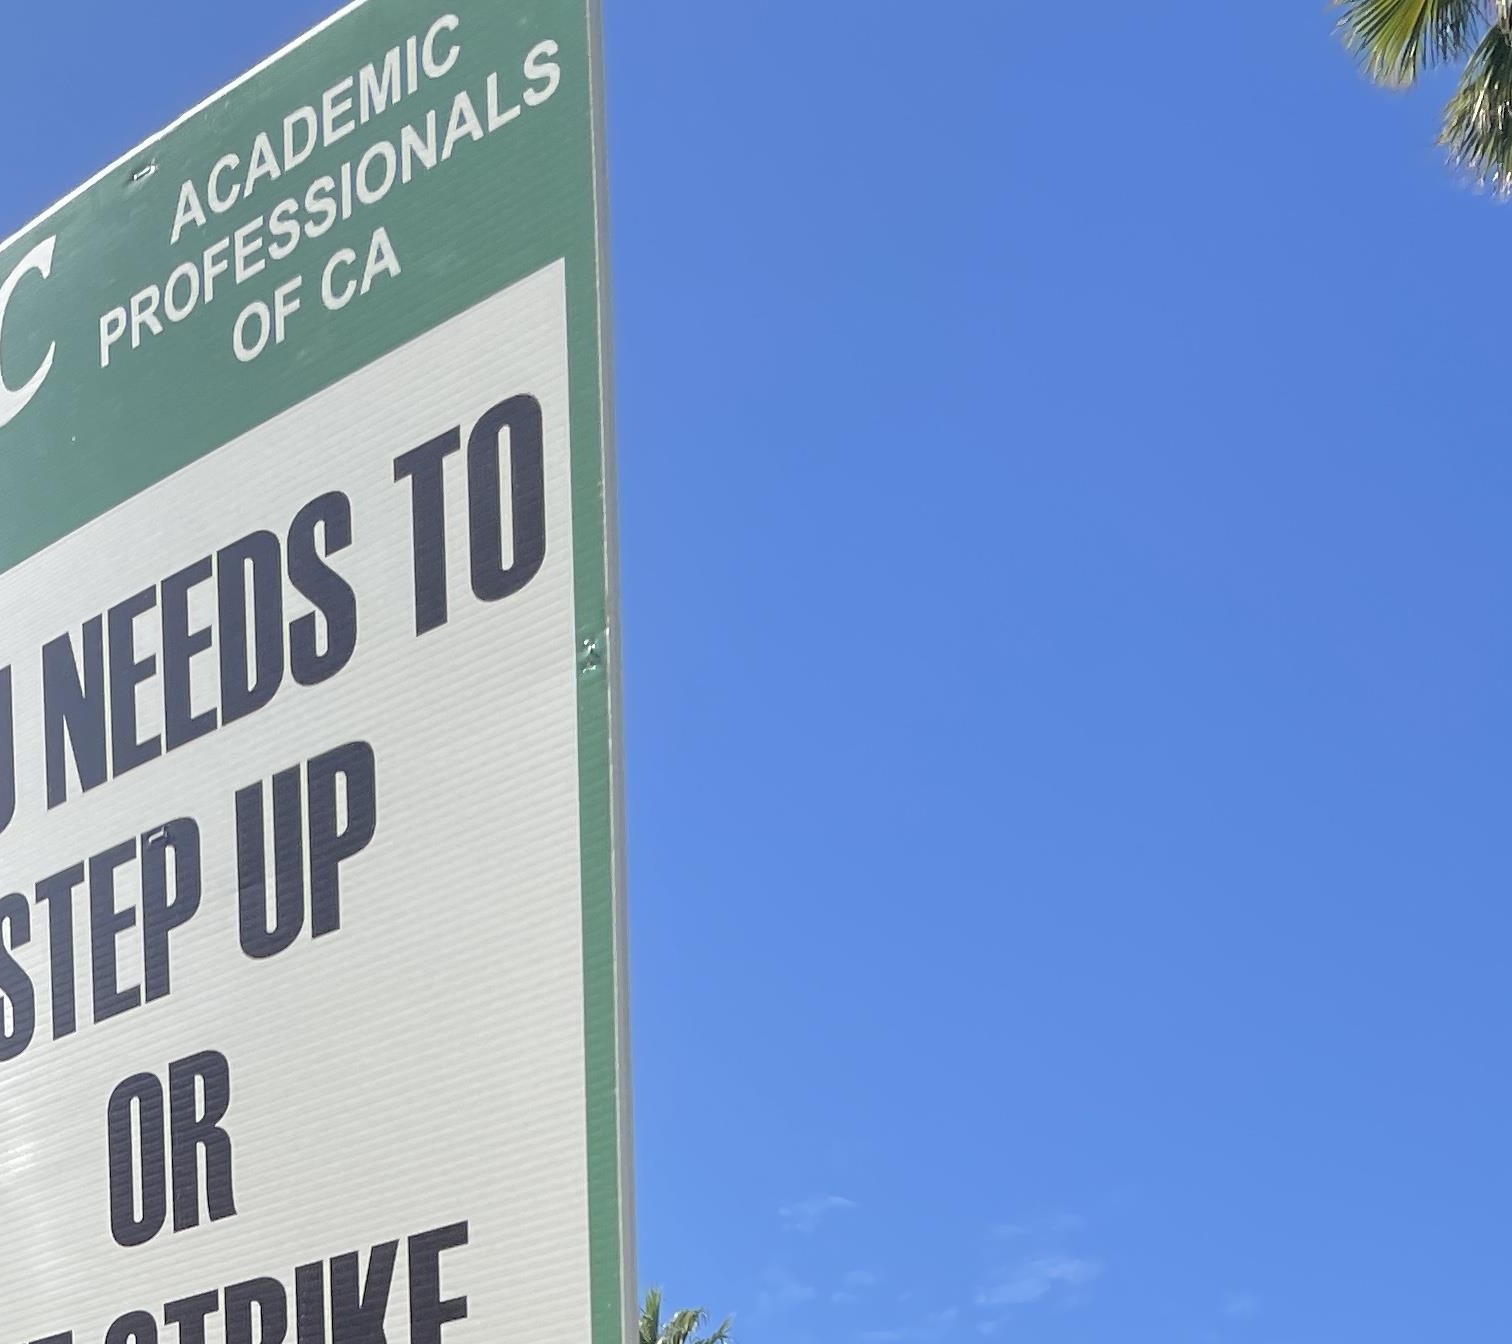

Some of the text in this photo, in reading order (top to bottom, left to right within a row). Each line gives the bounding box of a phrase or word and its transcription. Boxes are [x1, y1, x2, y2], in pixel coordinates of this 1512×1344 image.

[99, 38, 563, 369] PROFESSIONALS
[170, 13, 461, 246] ACADEMIC
[231, 226, 401, 365] OF CA
[41, 489, 359, 812] NEEDS
[392, 392, 547, 638] TO
[234, 740, 378, 960] UP
[106, 1049, 238, 1248] OR
